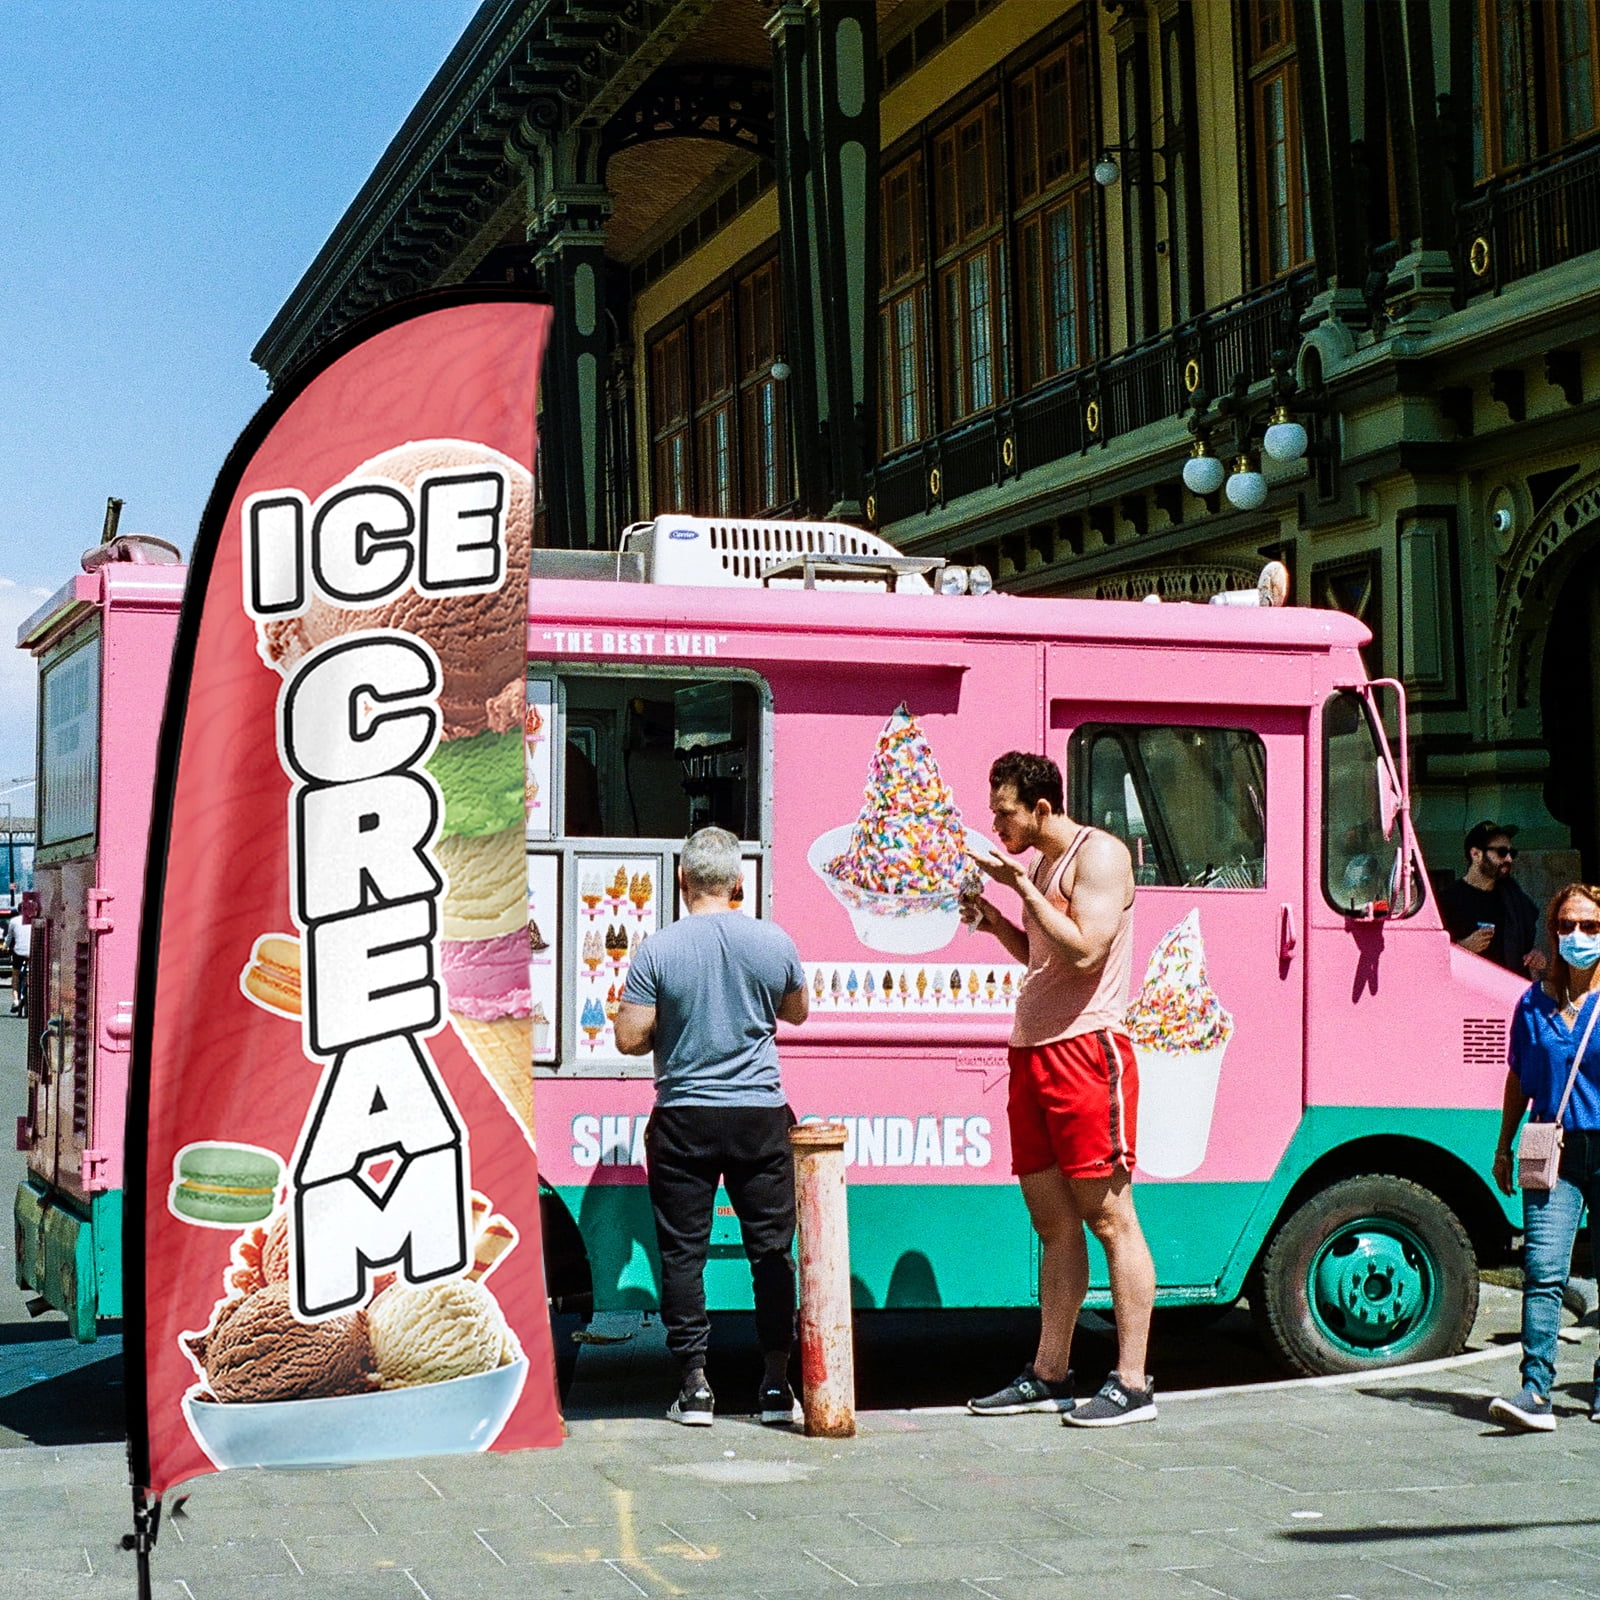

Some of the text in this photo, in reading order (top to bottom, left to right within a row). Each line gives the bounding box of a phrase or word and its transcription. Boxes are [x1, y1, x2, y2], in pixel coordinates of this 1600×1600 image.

[249, 471, 504, 614] ICE
[602, 632, 655, 655] BEST
[283, 632, 468, 1316] CREAM
[800, 1114, 992, 1167] UNDAES
